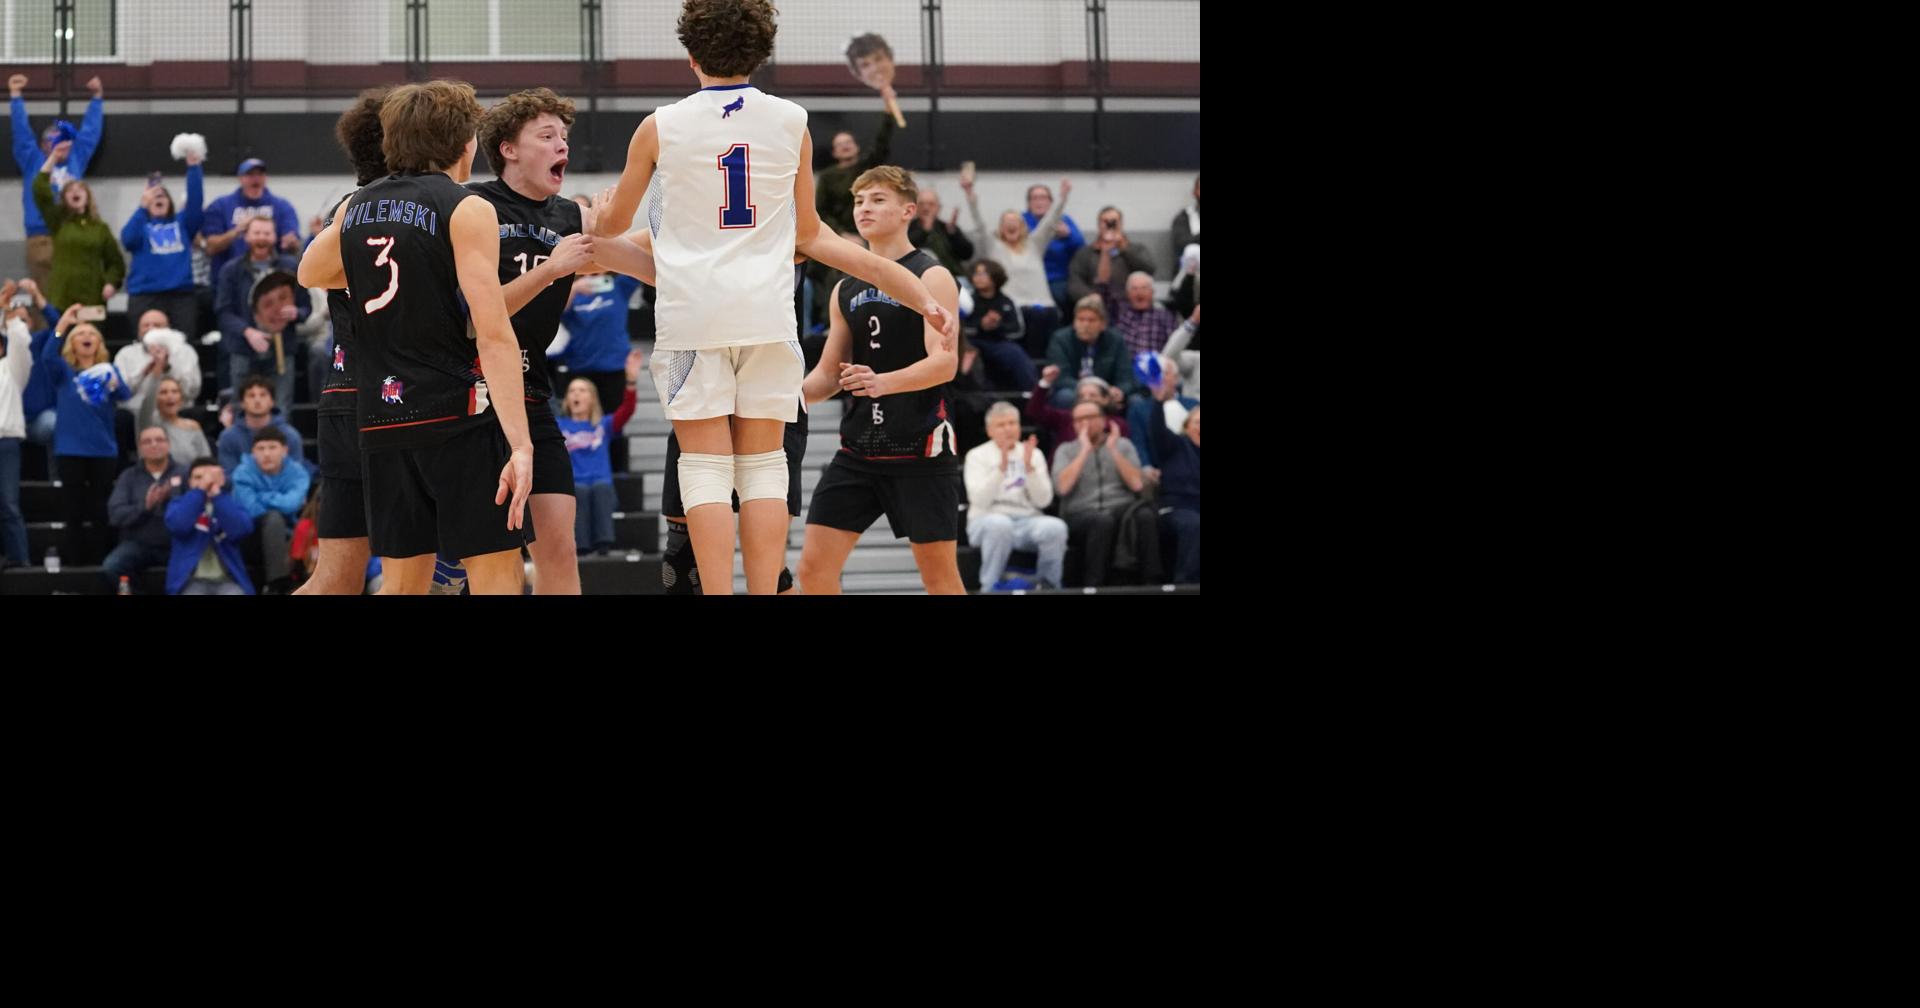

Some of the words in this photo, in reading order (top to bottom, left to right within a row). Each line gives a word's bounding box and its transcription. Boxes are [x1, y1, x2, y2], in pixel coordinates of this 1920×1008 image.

[717, 143, 756, 230] 1
[342, 199, 437, 236] WILEMSKI
[364, 236, 400, 315] 3
[867, 315, 882, 350] 2
